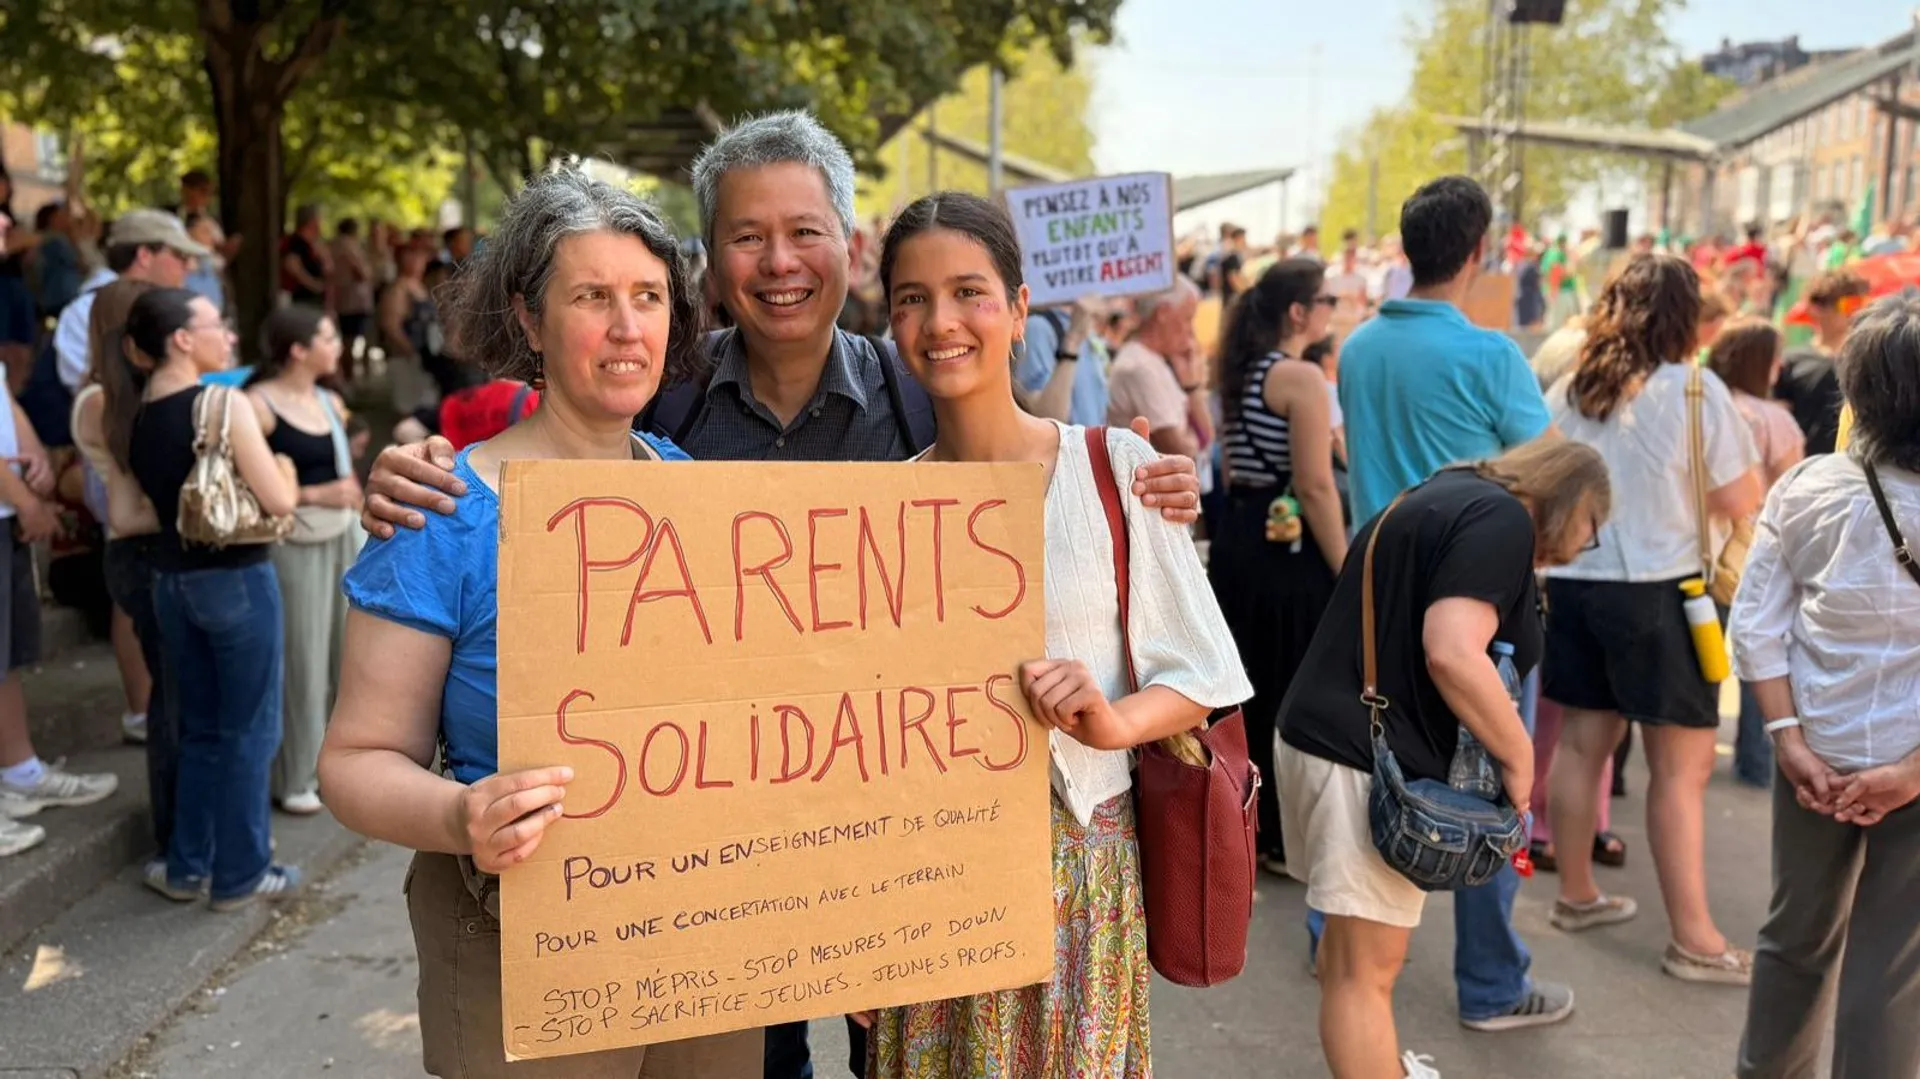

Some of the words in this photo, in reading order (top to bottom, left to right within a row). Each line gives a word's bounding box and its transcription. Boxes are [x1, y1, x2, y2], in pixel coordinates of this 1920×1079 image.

[1023, 189, 1090, 218] PENSEZ
[1116, 182, 1152, 206] NOS
[1047, 208, 1145, 244] ENFANTS
[1045, 264, 1096, 289] VOTRE
[547, 496, 1026, 655] PARENTS
[563, 855, 657, 902] POUR
[671, 849, 709, 874] UN
[899, 815, 926, 839] DE
[535, 929, 597, 958] POUR
[615, 916, 664, 942] UNE
[818, 886, 860, 905] AVEC
[871, 879, 890, 895] LE
[535, 1006, 619, 1043] STOP
[872, 955, 950, 983] JEUNES
[543, 981, 622, 1016] STOP
[743, 948, 799, 982] STOP
[810, 931, 887, 966] MESURES
[893, 921, 933, 945] TOP
[947, 905, 1008, 938] DOWN
